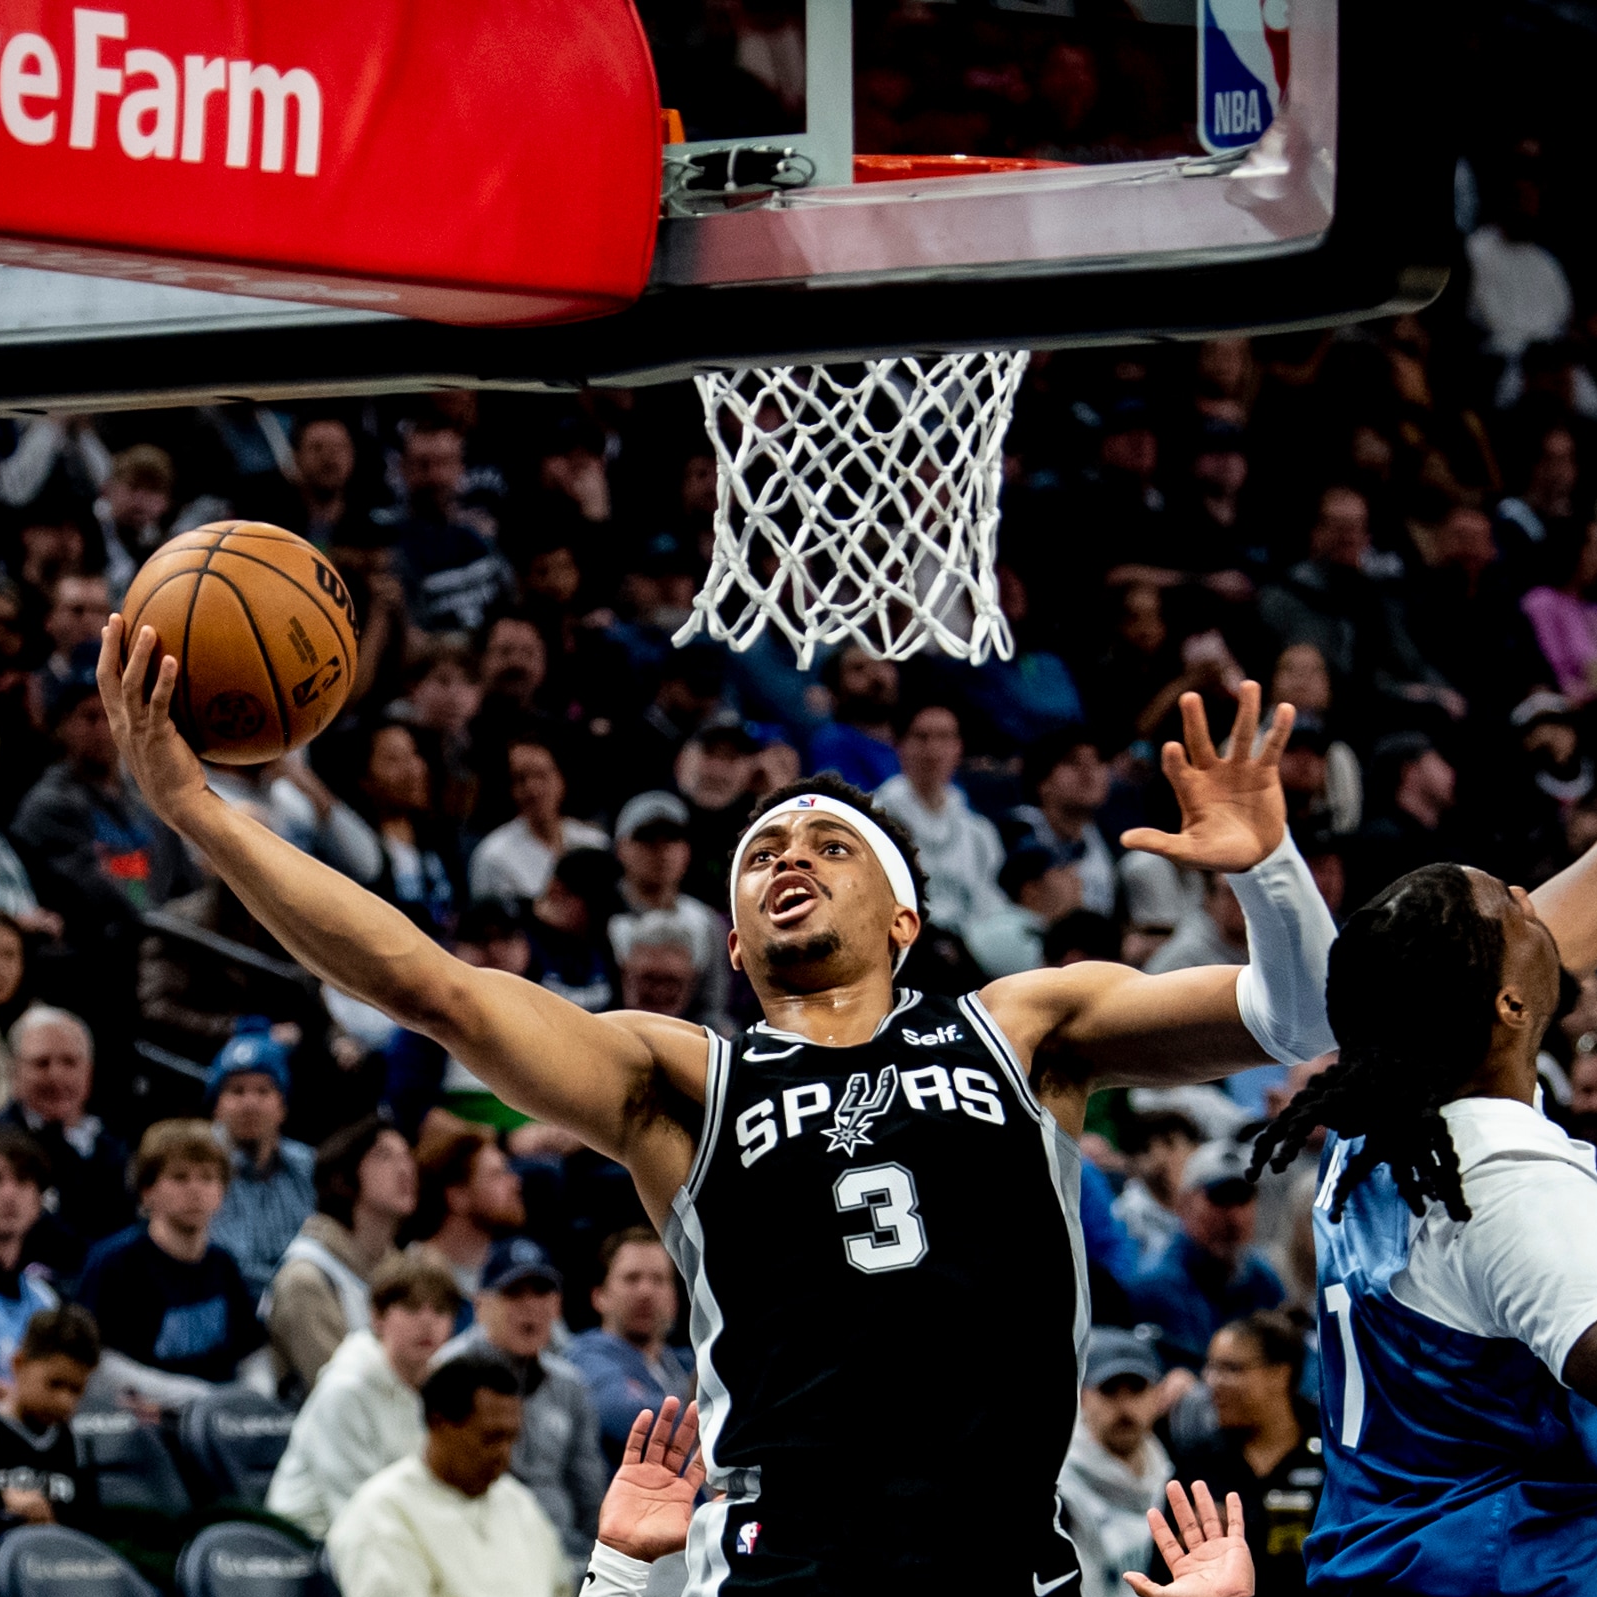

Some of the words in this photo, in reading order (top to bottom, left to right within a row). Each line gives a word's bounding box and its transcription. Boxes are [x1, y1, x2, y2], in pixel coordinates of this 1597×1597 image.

[1213, 88, 1262, 136] NBA
[735, 1063, 1006, 1169] SPURS
[832, 1161, 929, 1274] 3
